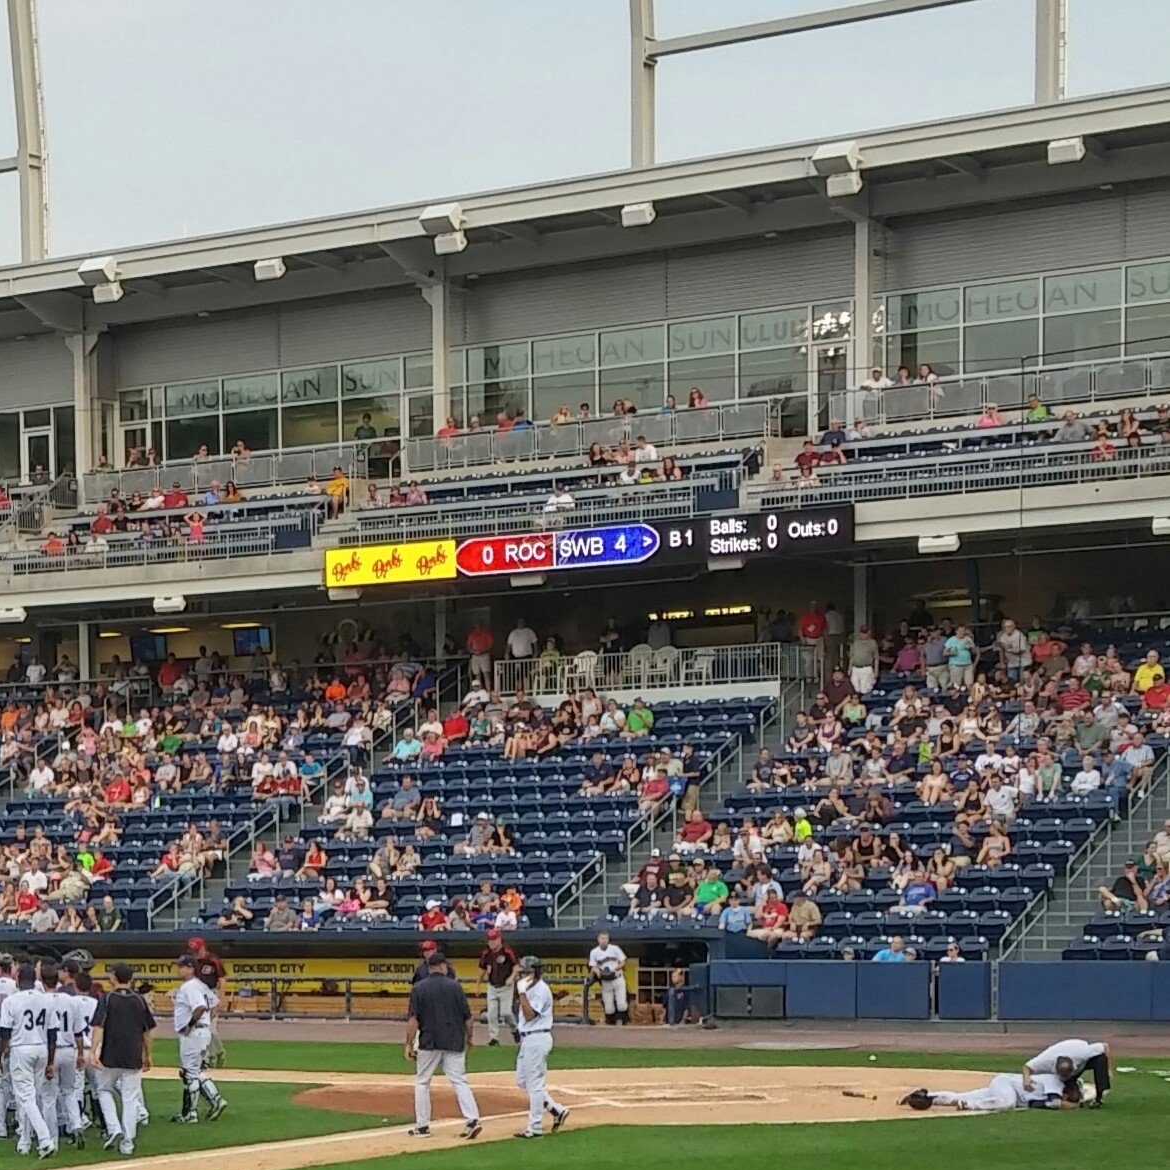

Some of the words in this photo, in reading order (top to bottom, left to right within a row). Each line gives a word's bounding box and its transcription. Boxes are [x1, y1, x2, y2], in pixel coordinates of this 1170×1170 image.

[907, 281, 1098, 325] MOHEGAN
[484, 338, 644, 376] MOHEGAN
[671, 326, 732, 353] SUN
[345, 368, 398, 392] SUN
[710, 518, 747, 536] Balls:
[767, 514, 778, 531] 0
[482, 547, 494, 564] 0
[505, 541, 547, 563] ROC
[559, 536, 604, 558] SWB
[614, 534, 626, 552] 4
[710, 535, 762, 555] Strikes:
[767, 532, 778, 549] 0
[149, 963, 173, 974] CITY
[233, 963, 277, 974] DICKSON
[280, 963, 305, 974] CITY
[368, 963, 415, 974] DICKSON
[23, 1008, 47, 1032] 34
